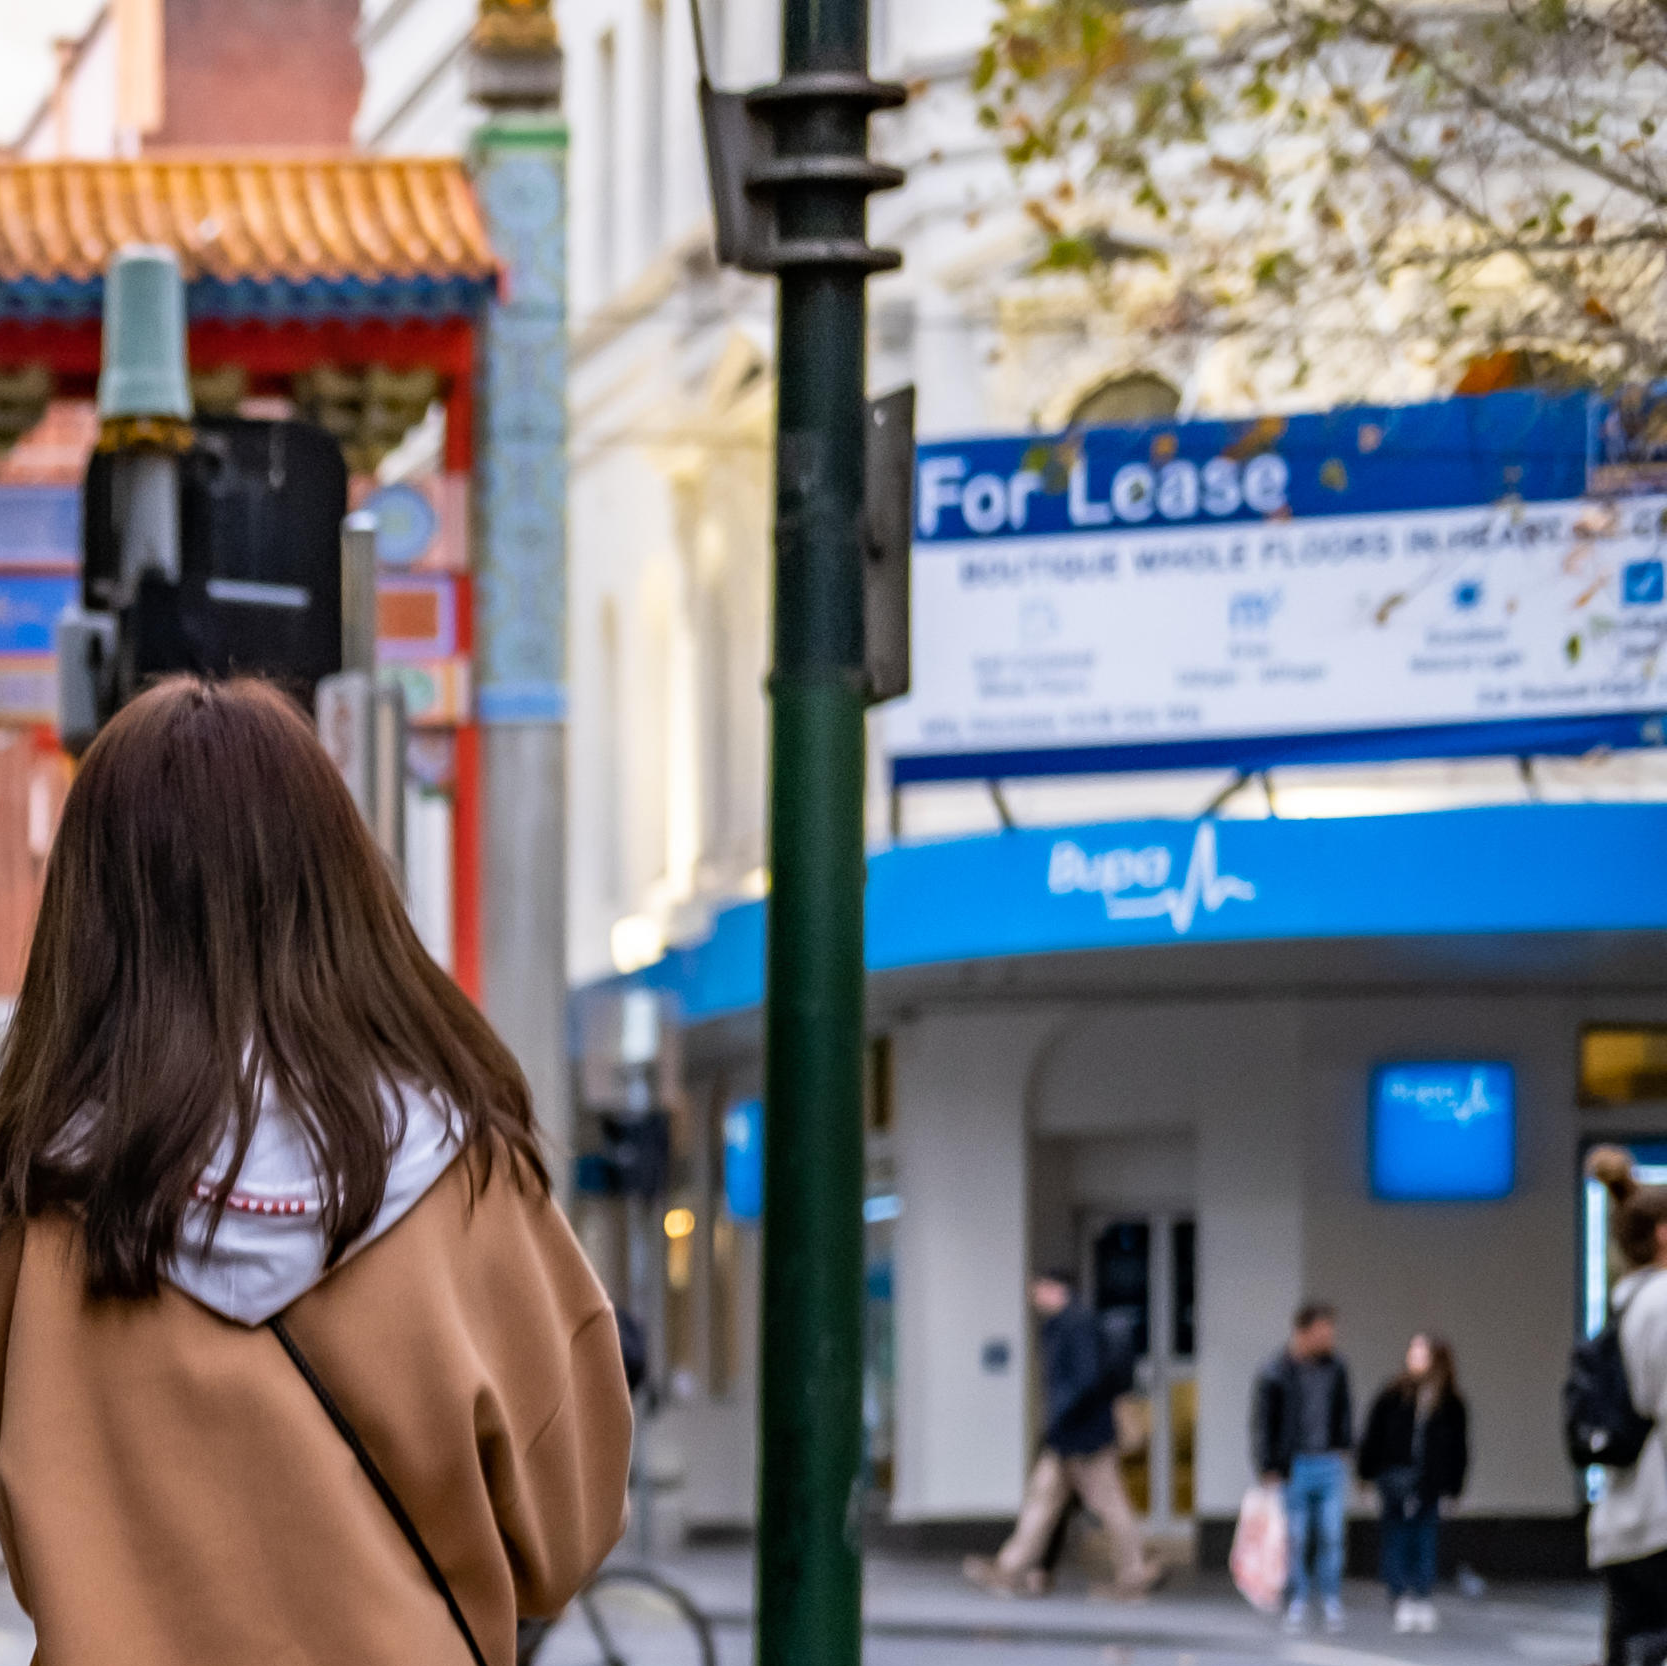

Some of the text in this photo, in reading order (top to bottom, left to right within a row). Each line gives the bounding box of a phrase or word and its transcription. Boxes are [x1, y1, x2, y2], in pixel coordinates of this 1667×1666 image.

[917, 452, 1290, 537] For Lease
[1134, 537, 1244, 575] WHOLE
[1261, 530, 1390, 568] FLOORS
